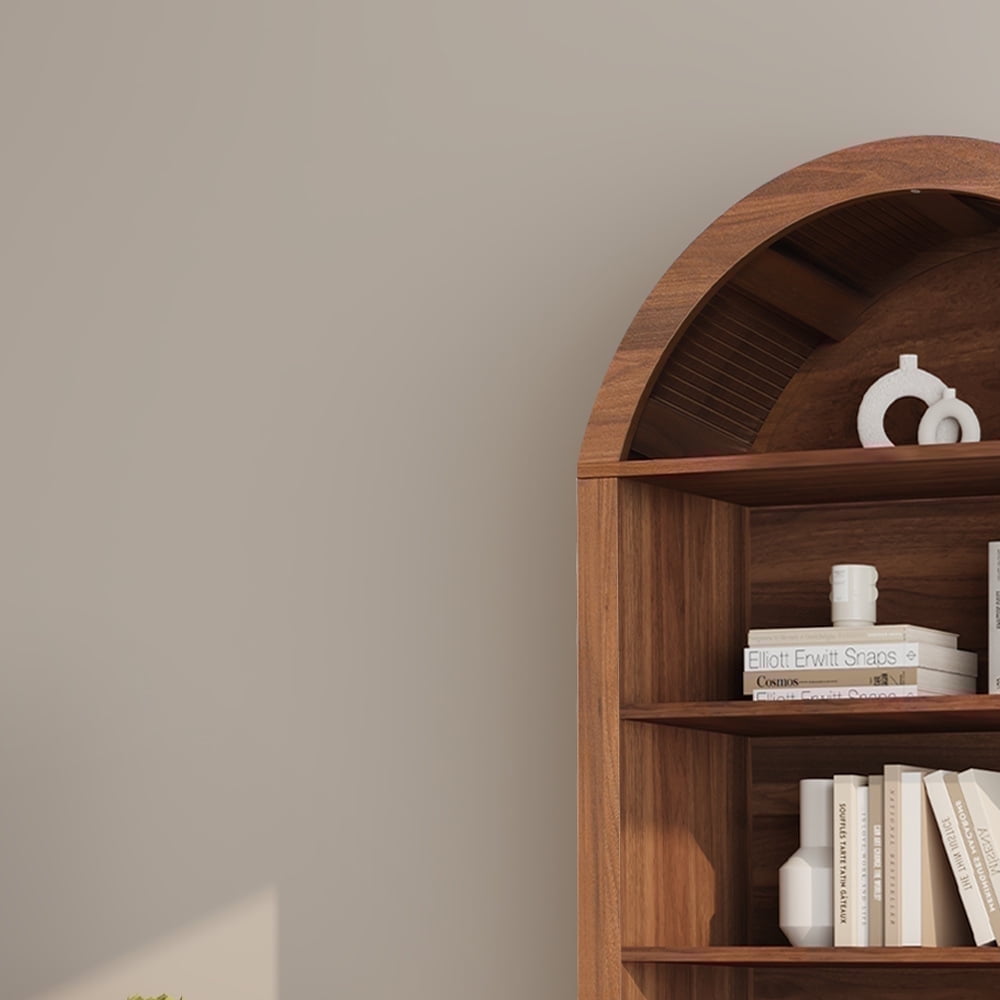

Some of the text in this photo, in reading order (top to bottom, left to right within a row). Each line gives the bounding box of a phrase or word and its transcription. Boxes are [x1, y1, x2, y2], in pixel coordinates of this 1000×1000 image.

[749, 647, 898, 669] Elliott Erwitt Snaps
[756, 675, 800, 688] Cosmos
